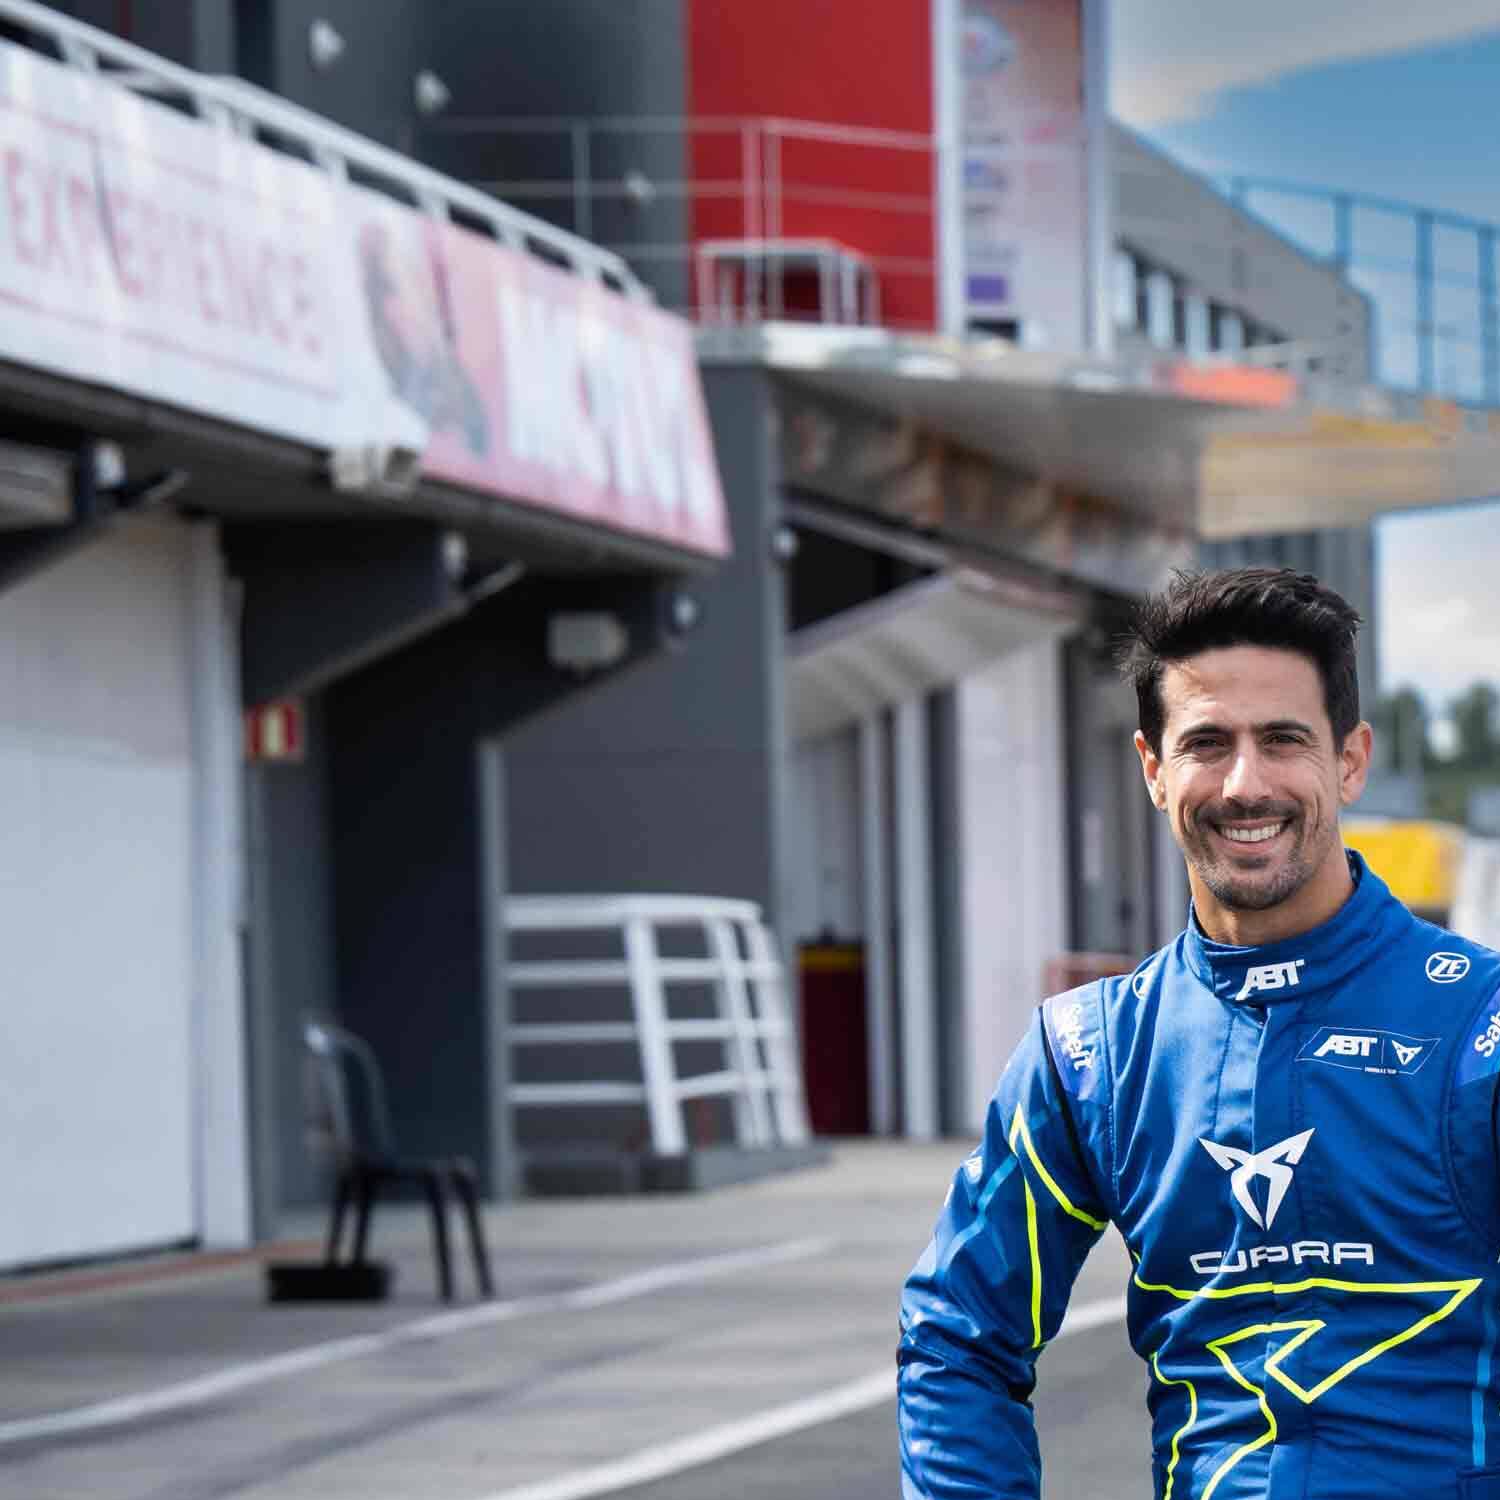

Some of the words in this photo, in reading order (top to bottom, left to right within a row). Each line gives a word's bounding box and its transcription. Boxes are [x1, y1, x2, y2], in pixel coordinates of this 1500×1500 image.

[1235, 959, 1304, 1001] ABT
[1427, 954, 1469, 981] ZF
[1313, 1034, 1378, 1057] ABT
[1189, 1240, 1375, 1275] CUPRA
